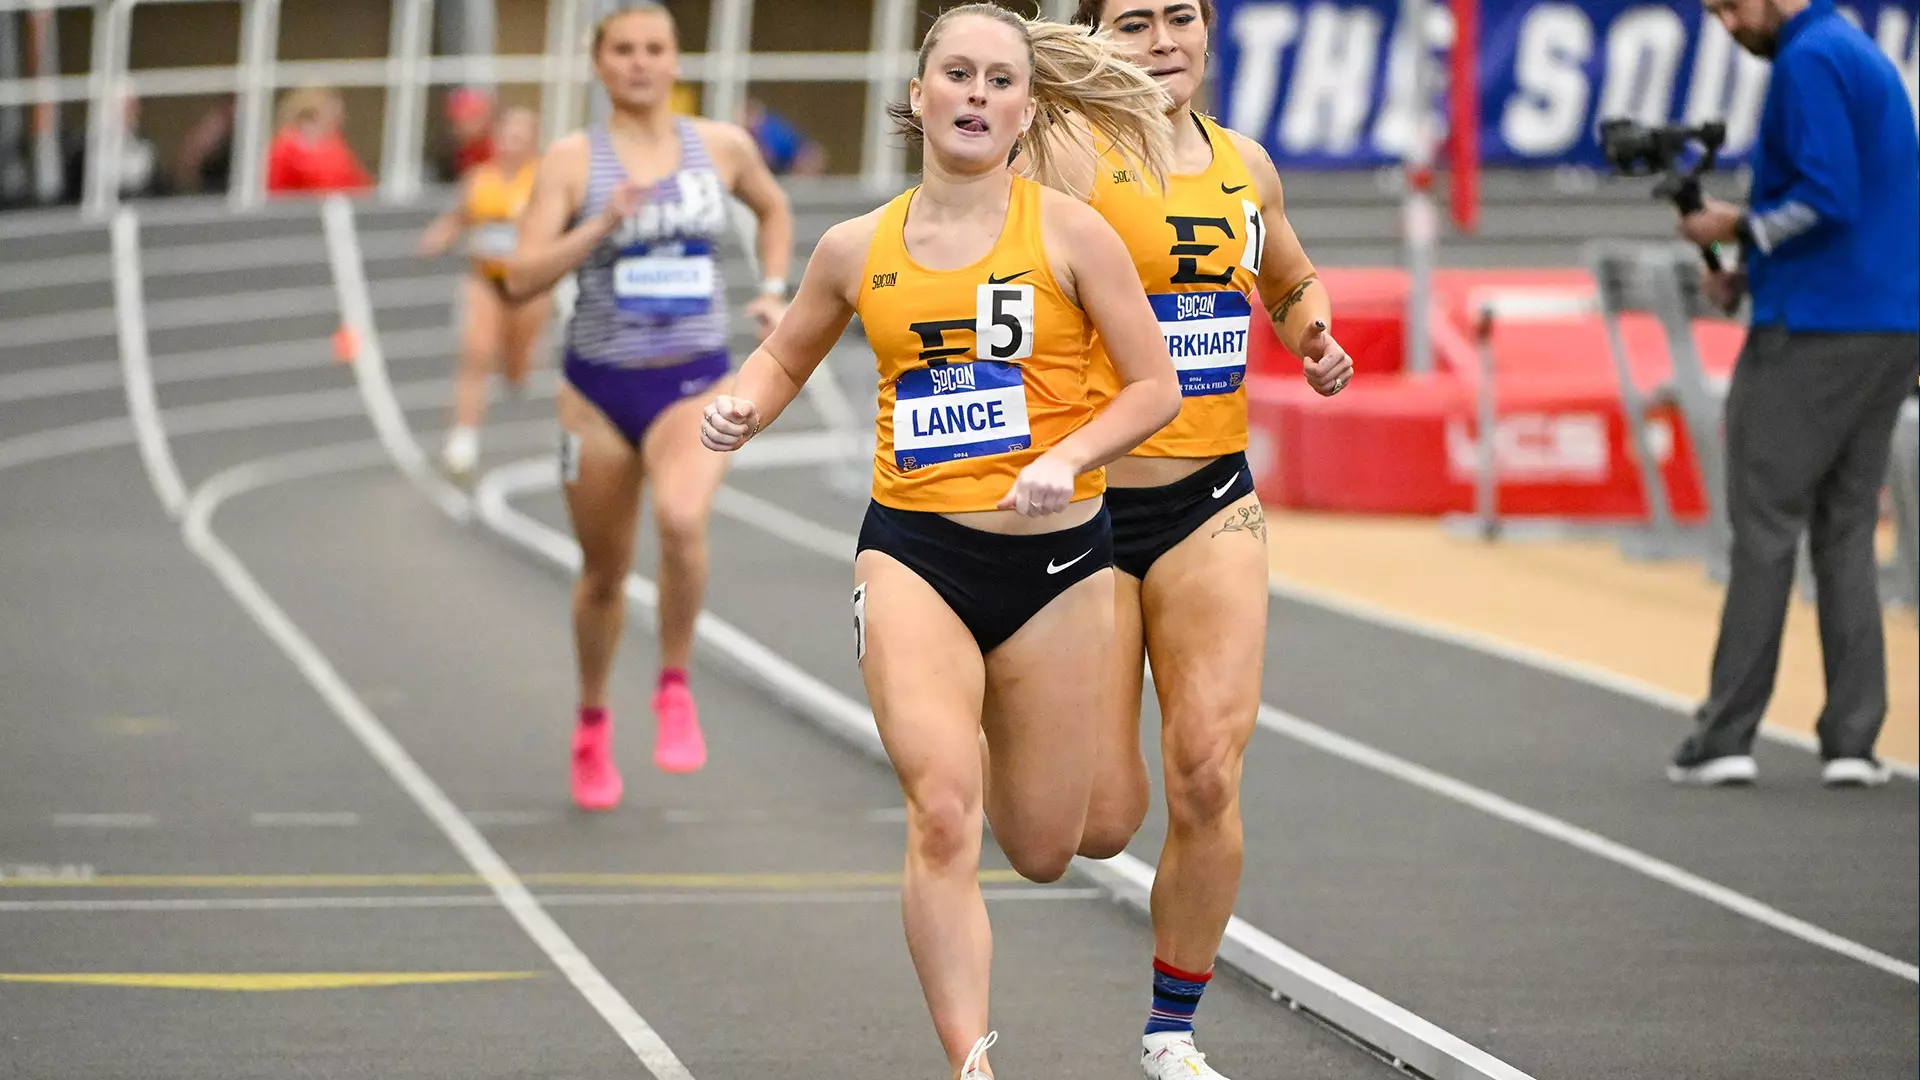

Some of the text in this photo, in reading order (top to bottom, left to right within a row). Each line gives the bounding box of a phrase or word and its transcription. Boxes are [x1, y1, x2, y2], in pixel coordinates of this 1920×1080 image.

[1229, 3, 1456, 158] THE
[1165, 215, 1236, 286] E
[990, 289, 1023, 358] 5
[1164, 329, 1247, 358] RKHART
[1185, 383, 1206, 391] TRACK
[1212, 381, 1228, 389] FIELD
[911, 400, 1006, 438] LANCE
